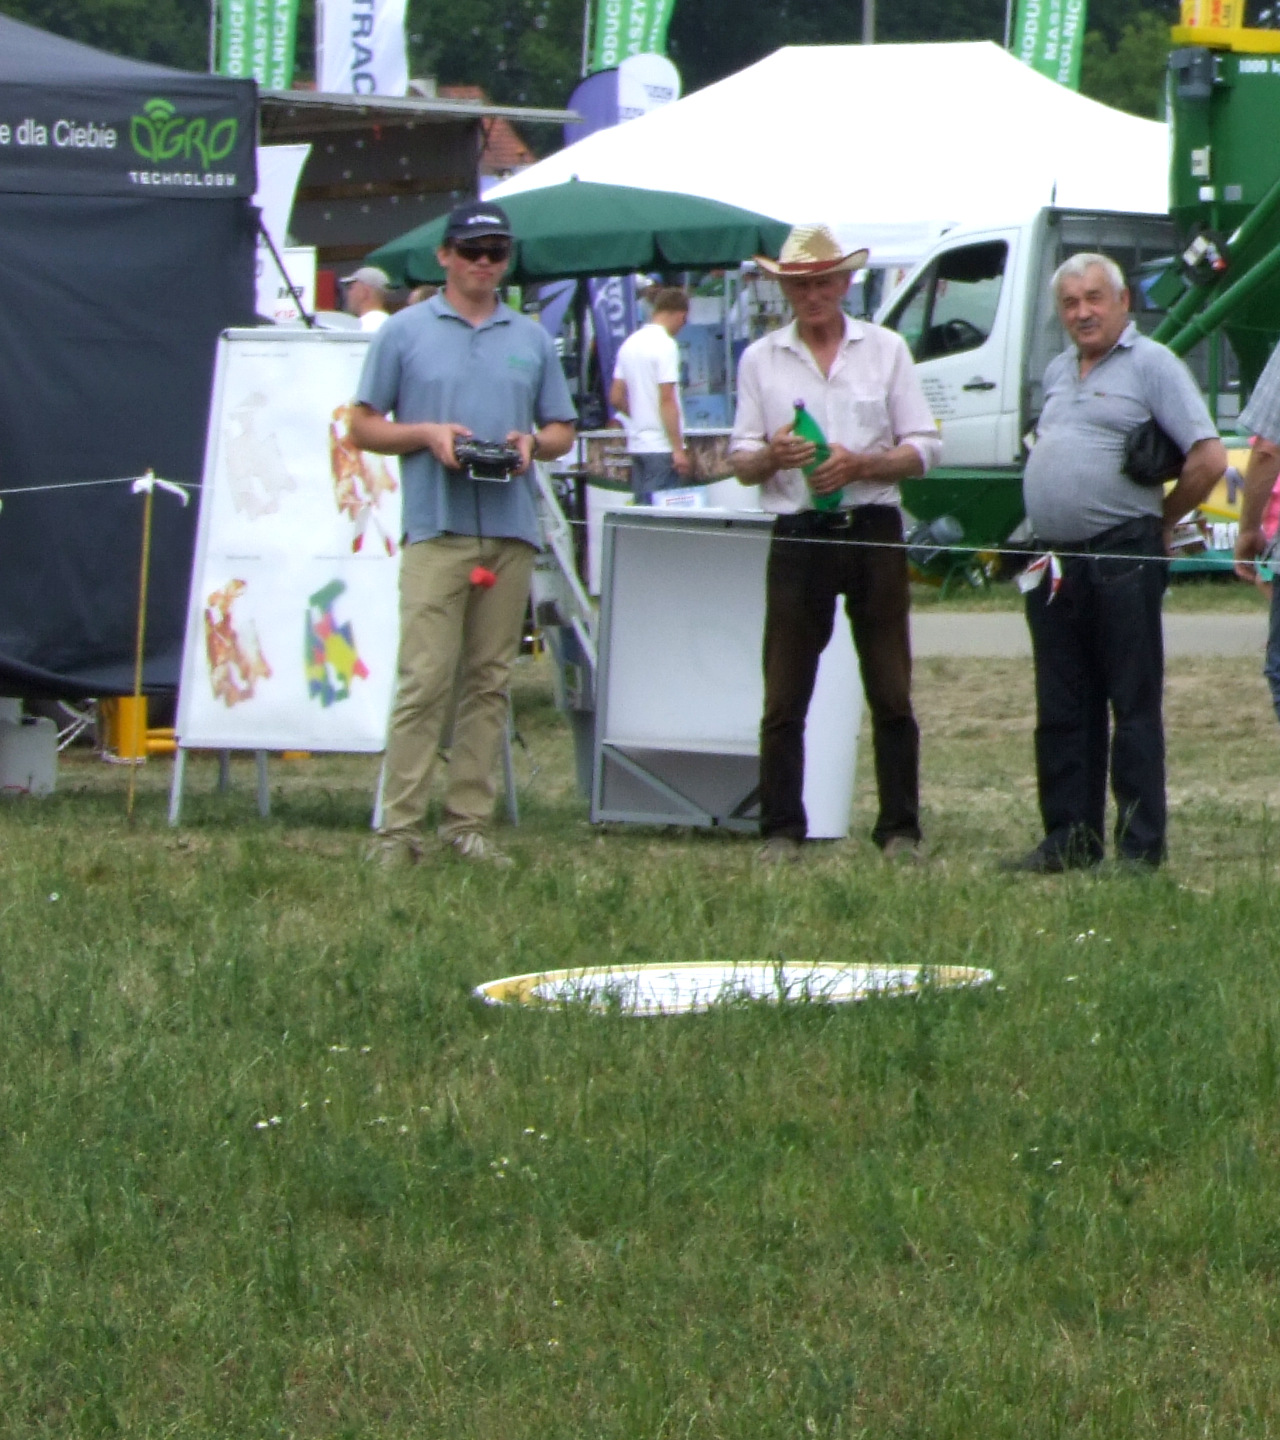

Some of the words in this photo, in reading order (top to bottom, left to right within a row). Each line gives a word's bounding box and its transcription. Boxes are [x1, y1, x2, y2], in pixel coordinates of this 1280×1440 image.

[15, 118, 48, 146] dla
[53, 119, 117, 149] Ciebie
[128, 171, 237, 187] TECHNOLOGY
